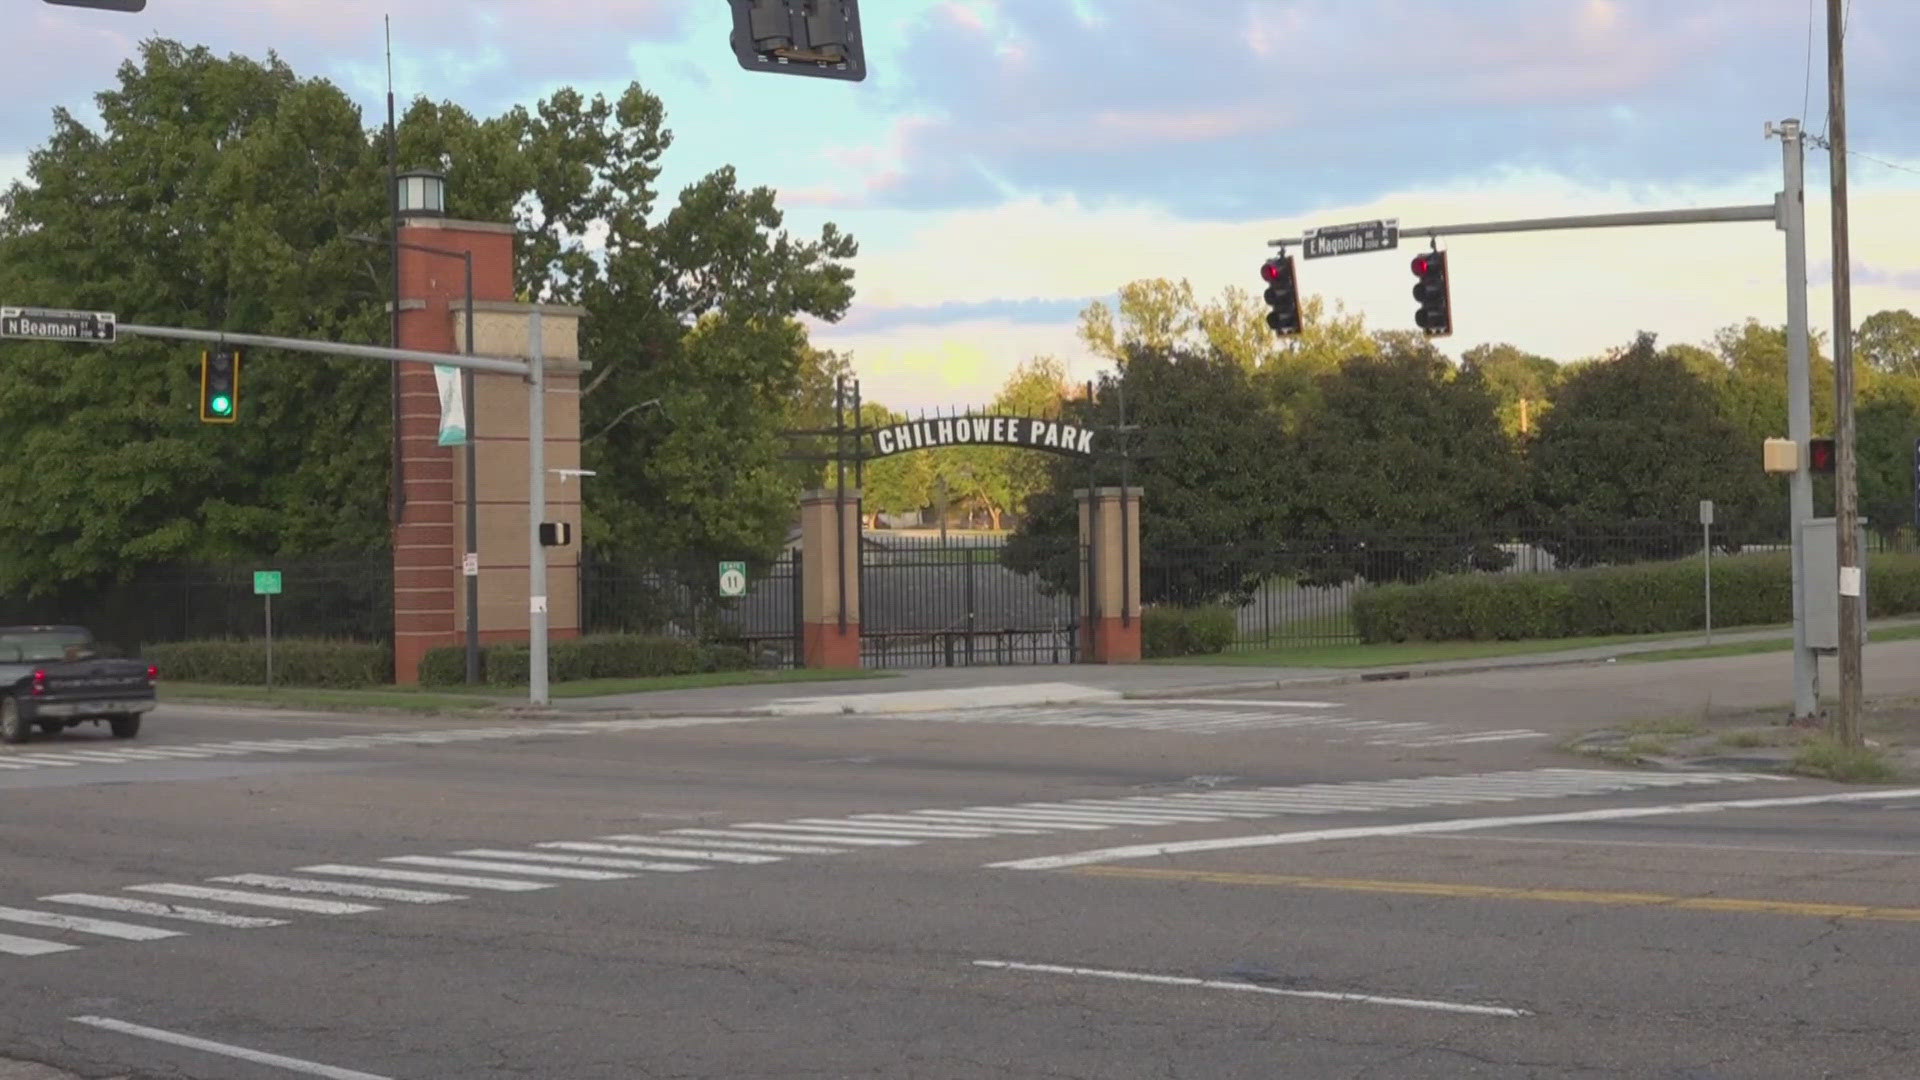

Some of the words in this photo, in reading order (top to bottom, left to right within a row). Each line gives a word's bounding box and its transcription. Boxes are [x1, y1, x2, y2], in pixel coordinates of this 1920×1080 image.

[1310, 240, 1317, 255] E
[1318, 232, 1363, 256] Magnolia
[9, 320, 17, 334] N
[20, 318, 77, 337] Beaman
[878, 418, 1019, 454] CHILHOWEE
[1030, 420, 1094, 454] PARK
[728, 575, 738, 588] 11
